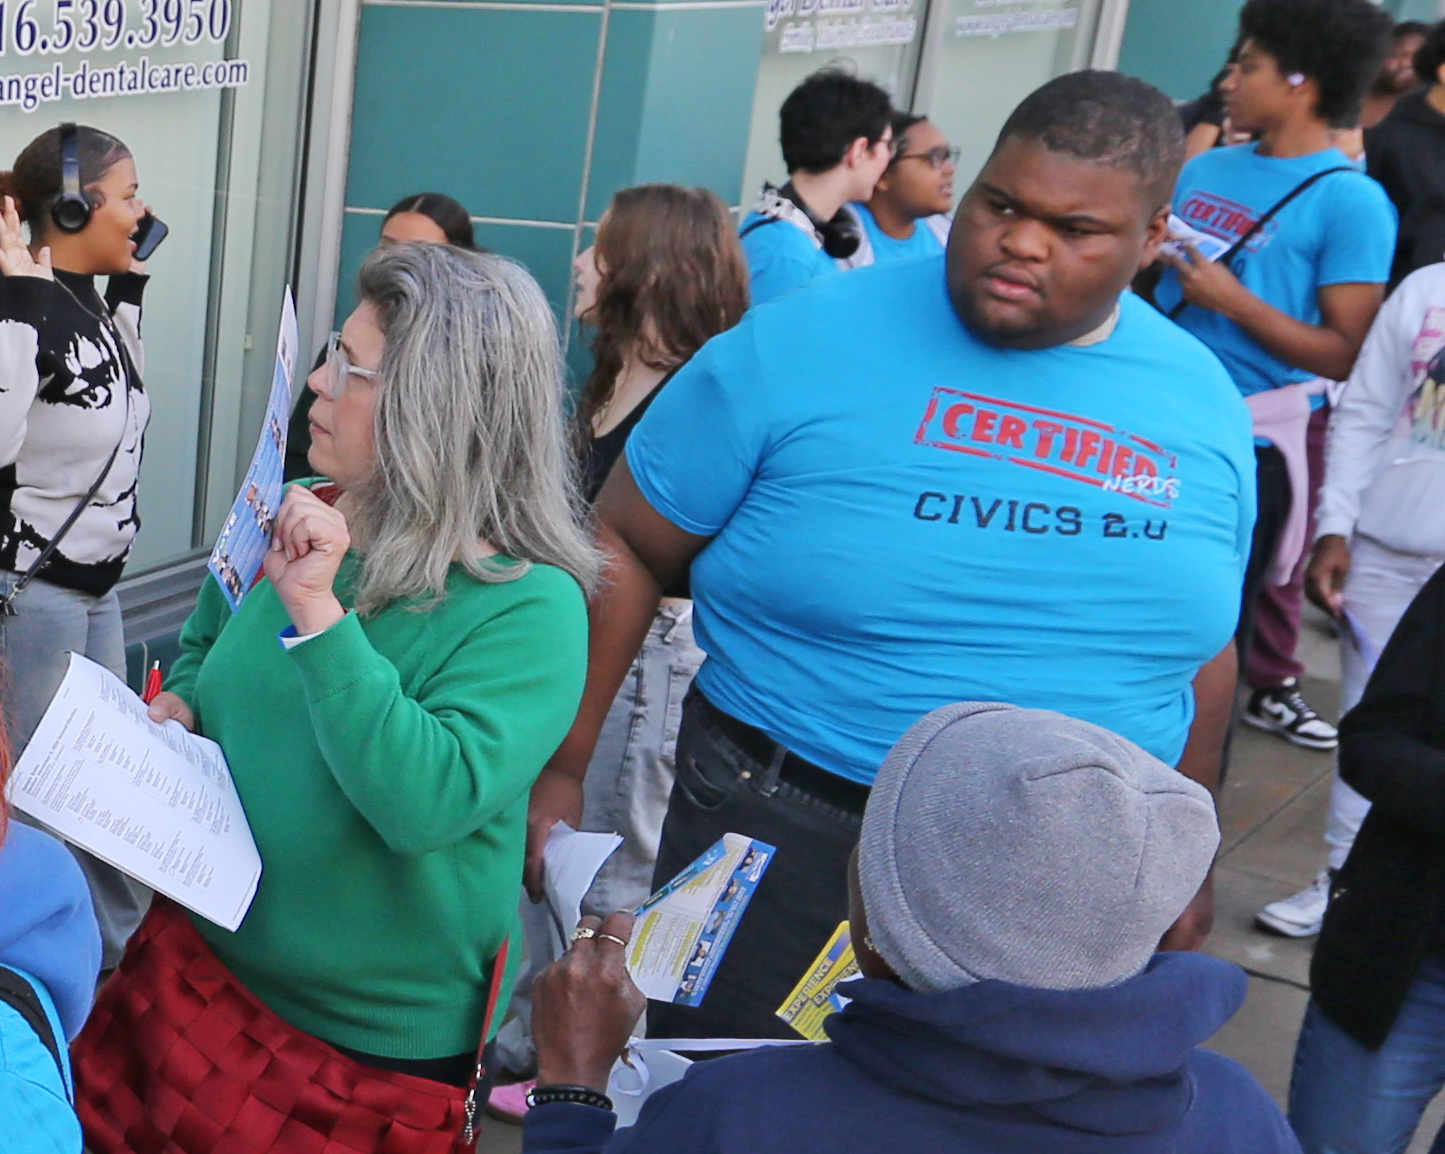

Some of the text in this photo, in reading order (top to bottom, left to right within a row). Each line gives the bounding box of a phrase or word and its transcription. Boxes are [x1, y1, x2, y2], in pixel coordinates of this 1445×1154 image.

[942, 402, 1160, 488] CERTIFIED
[1102, 473, 1182, 499] NERDS
[913, 491, 1084, 536] CIVICS
